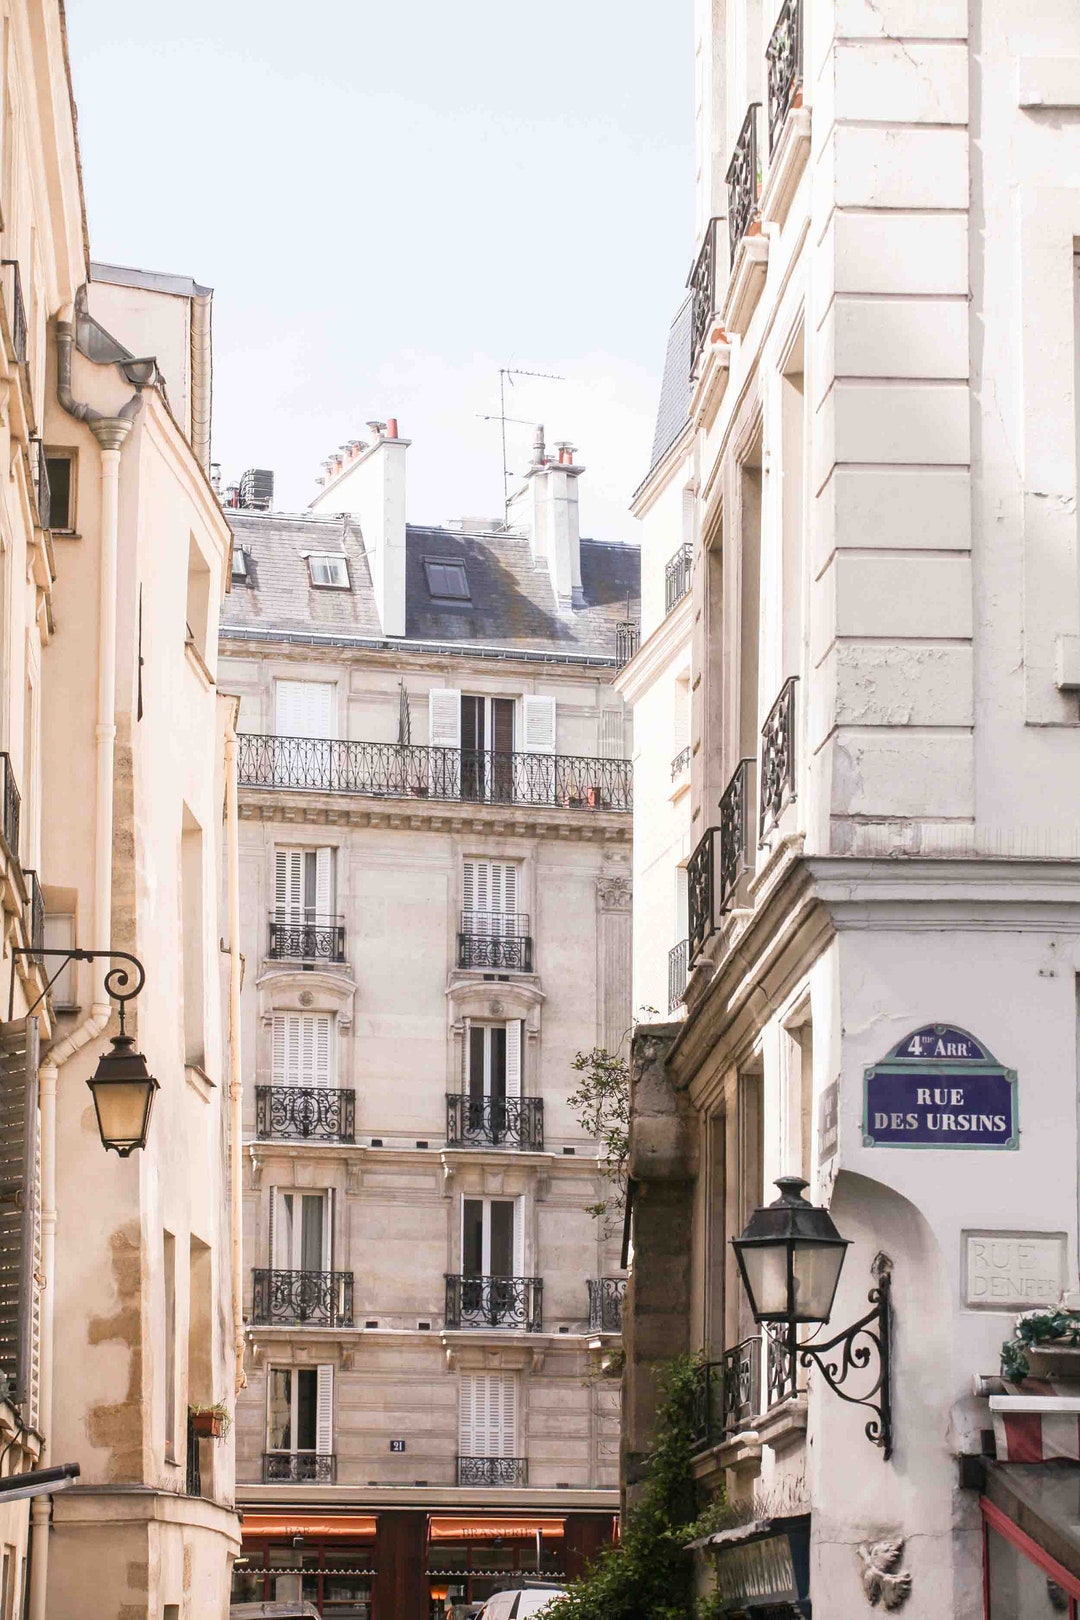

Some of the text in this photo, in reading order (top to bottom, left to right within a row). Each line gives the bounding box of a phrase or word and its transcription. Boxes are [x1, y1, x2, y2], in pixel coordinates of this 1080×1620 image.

[917, 1088, 964, 1106] RUE
[874, 1112, 1007, 1132] DES URSINS
[973, 1243, 1036, 1269] RUE
[393, 1441, 403, 1451] 21
[462, 1527, 533, 1538] BRASSERIE
